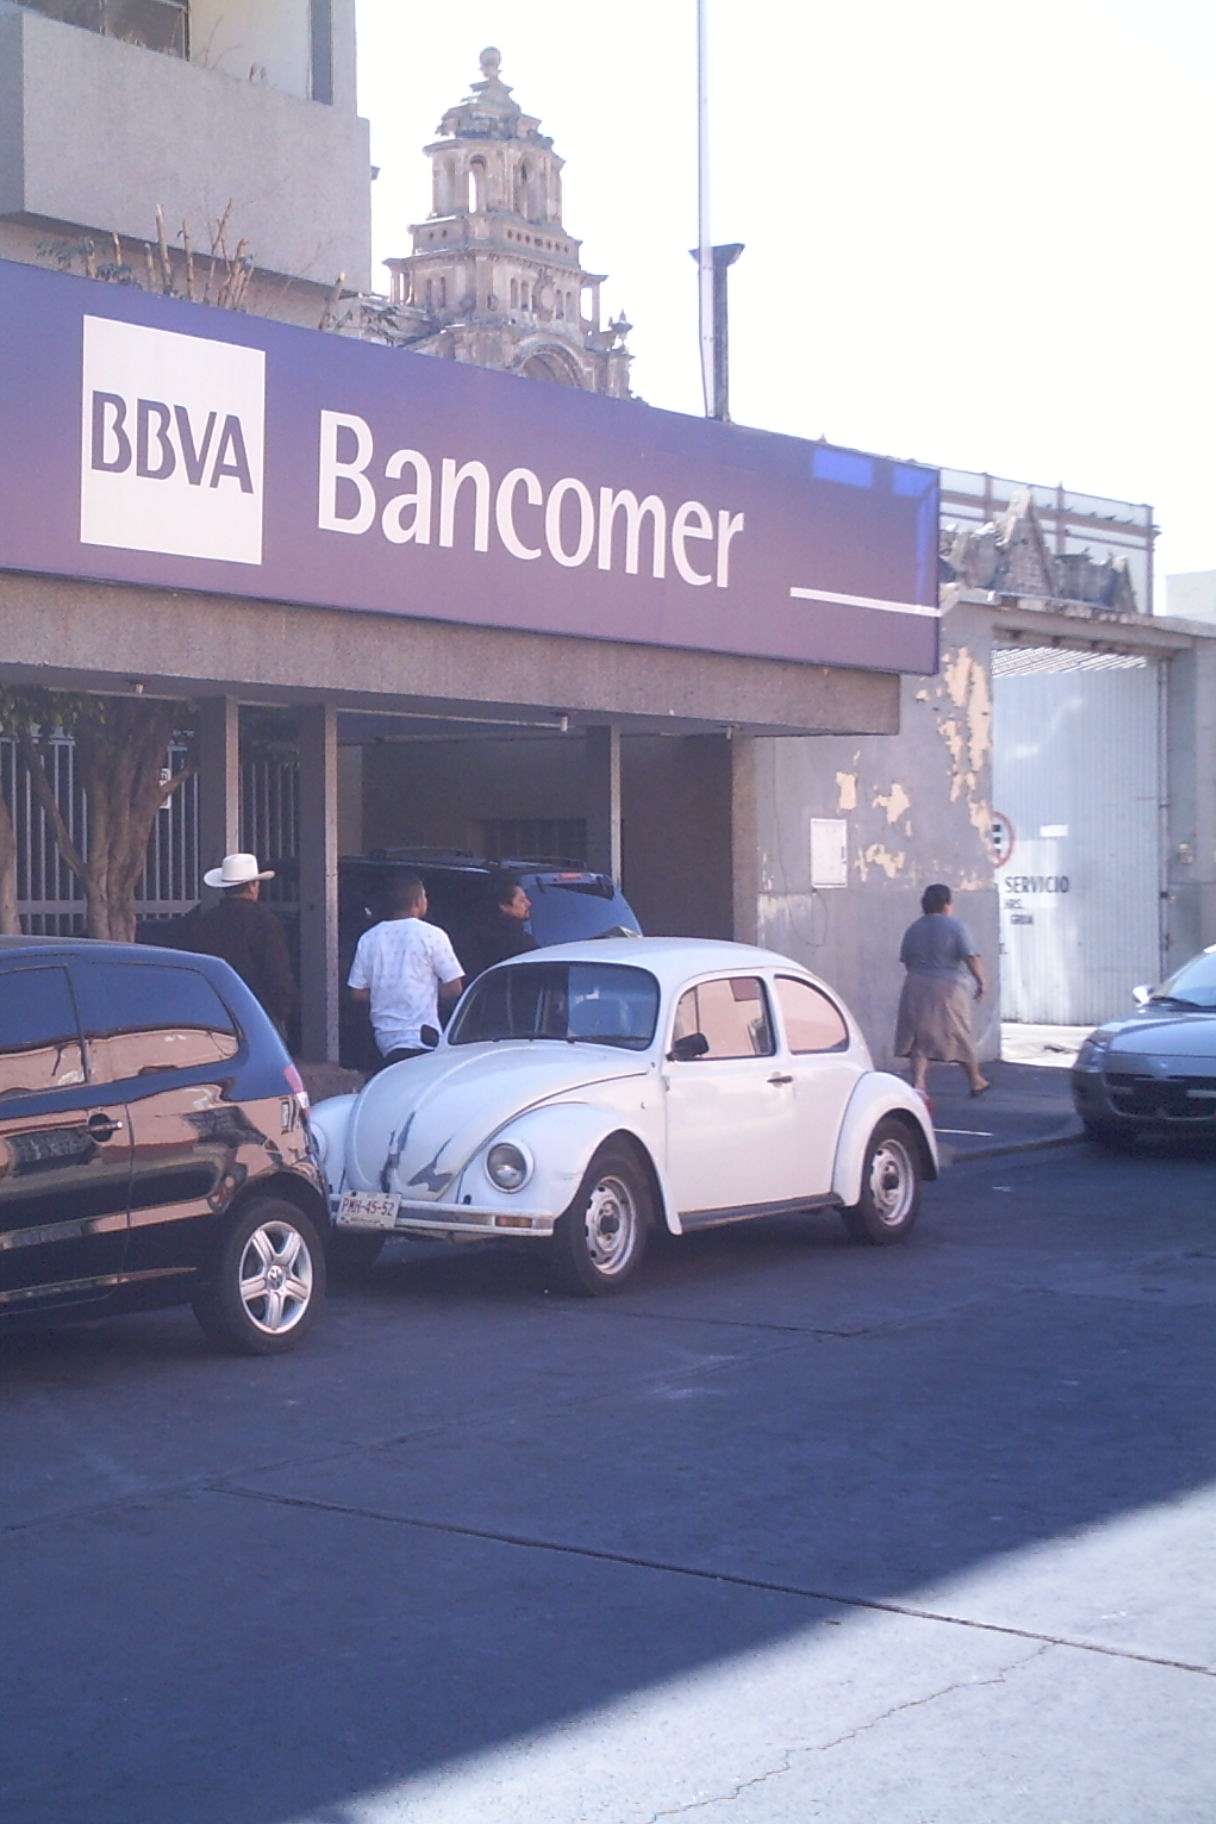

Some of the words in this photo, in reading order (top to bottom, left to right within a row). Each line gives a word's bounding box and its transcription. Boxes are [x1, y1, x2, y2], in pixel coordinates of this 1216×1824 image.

[90, 390, 255, 494] BBVA
[317, 409, 745, 589] Bancomer
[1004, 875, 1070, 894] SERVICIO
